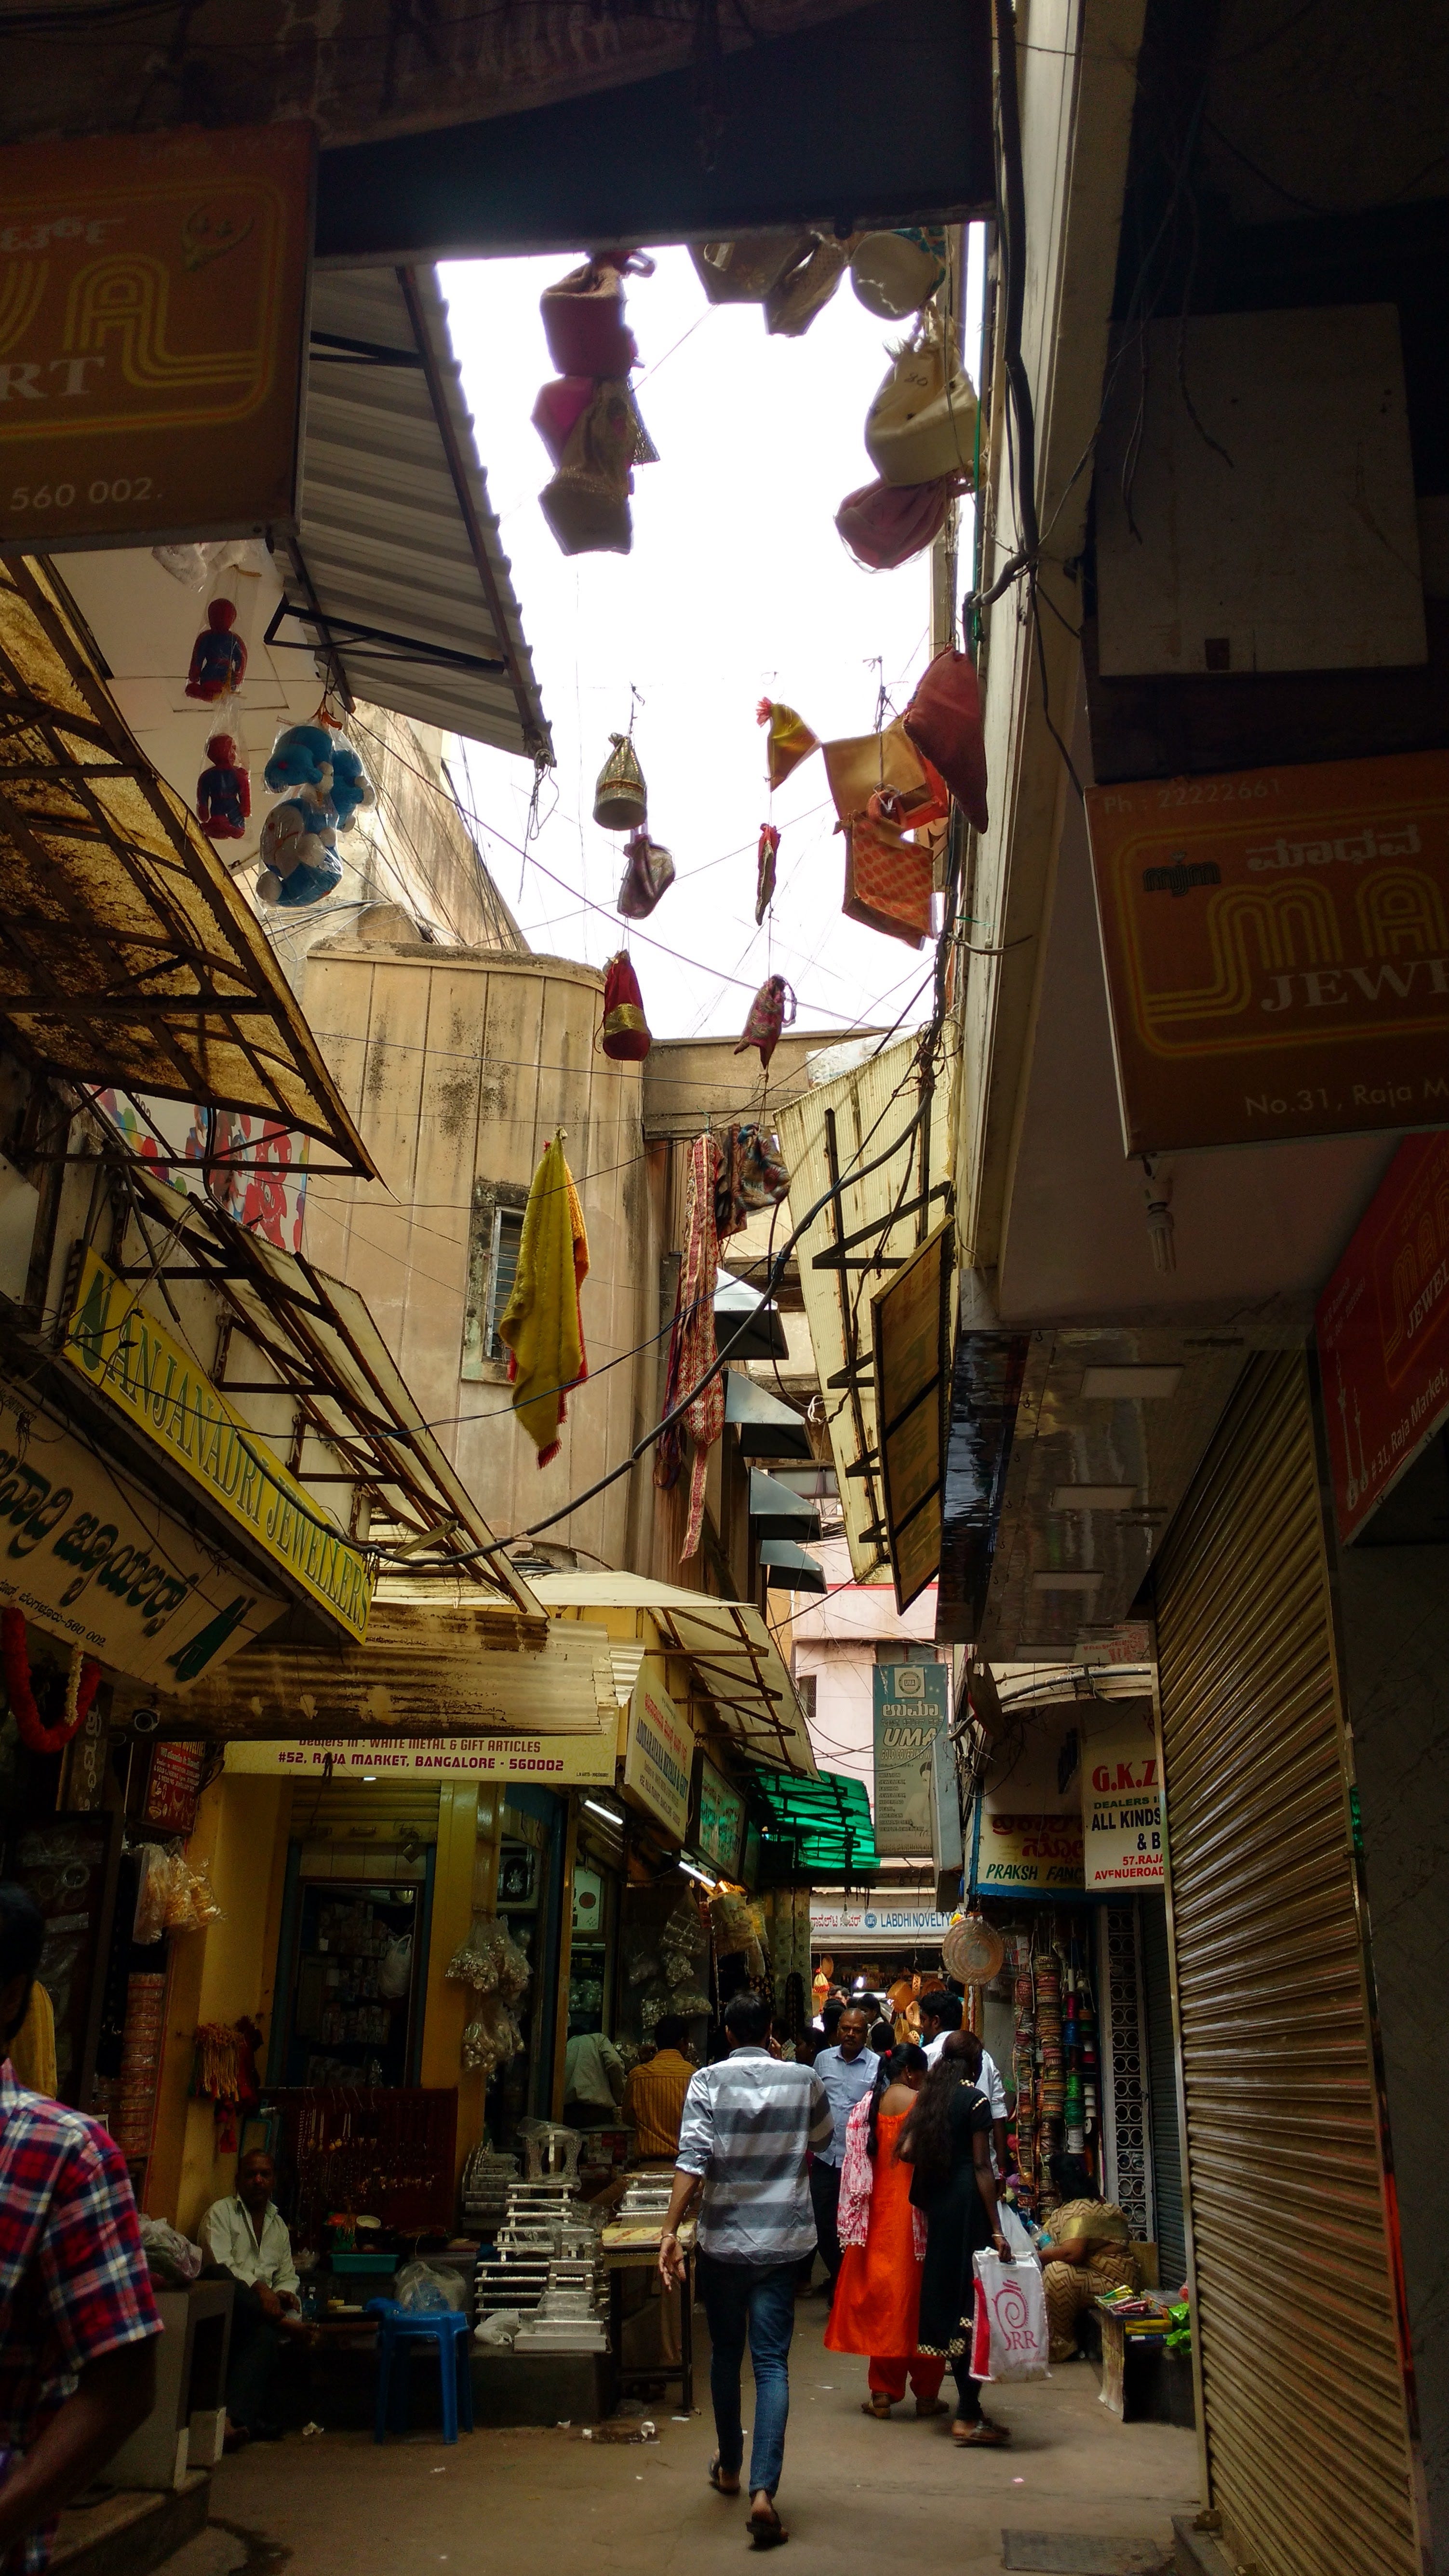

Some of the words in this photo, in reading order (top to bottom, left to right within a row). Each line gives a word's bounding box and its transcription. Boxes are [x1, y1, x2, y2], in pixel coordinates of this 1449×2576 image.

[9, 484, 75, 511] 560
[89, 478, 163, 504] 002.
[1104, 794, 1131, 814] Ph
[1158, 778, 1281, 809] 22222661
[1353, 1081, 1413, 1108] Raja
[1391, 1417, 1410, 1454] Raja
[107, 1309, 269, 1527] ANJANADRI
[268, 1473, 372, 1633] JEWELLERS
[370, 1739, 404, 1749] WHITE
[408, 1739, 446, 1750] METAL
[450, 1740, 456, 1750] &
[460, 1740, 483, 1752] GIFT
[488, 1741, 541, 1753] ARTICLES
[883, 1727, 937, 1746] UMA
[278, 1752, 307, 1764] #52,
[351, 1755, 409, 1768] MARKET,
[415, 1756, 495, 1769] BANGALORE
[509, 1759, 564, 1771] 560002
[881, 1749, 895, 1759] GOLD
[897, 1748, 923, 1759] COVERING
[1094, 1797, 1149, 1809] DEALERS
[1091, 1812, 1116, 1831] ALL
[1120, 1808, 1161, 1828] KINDS
[1137, 1833, 1147, 1851] &
[986, 1864, 1038, 1880] PRAKSH
[881, 1913, 912, 1928] LABDHI
